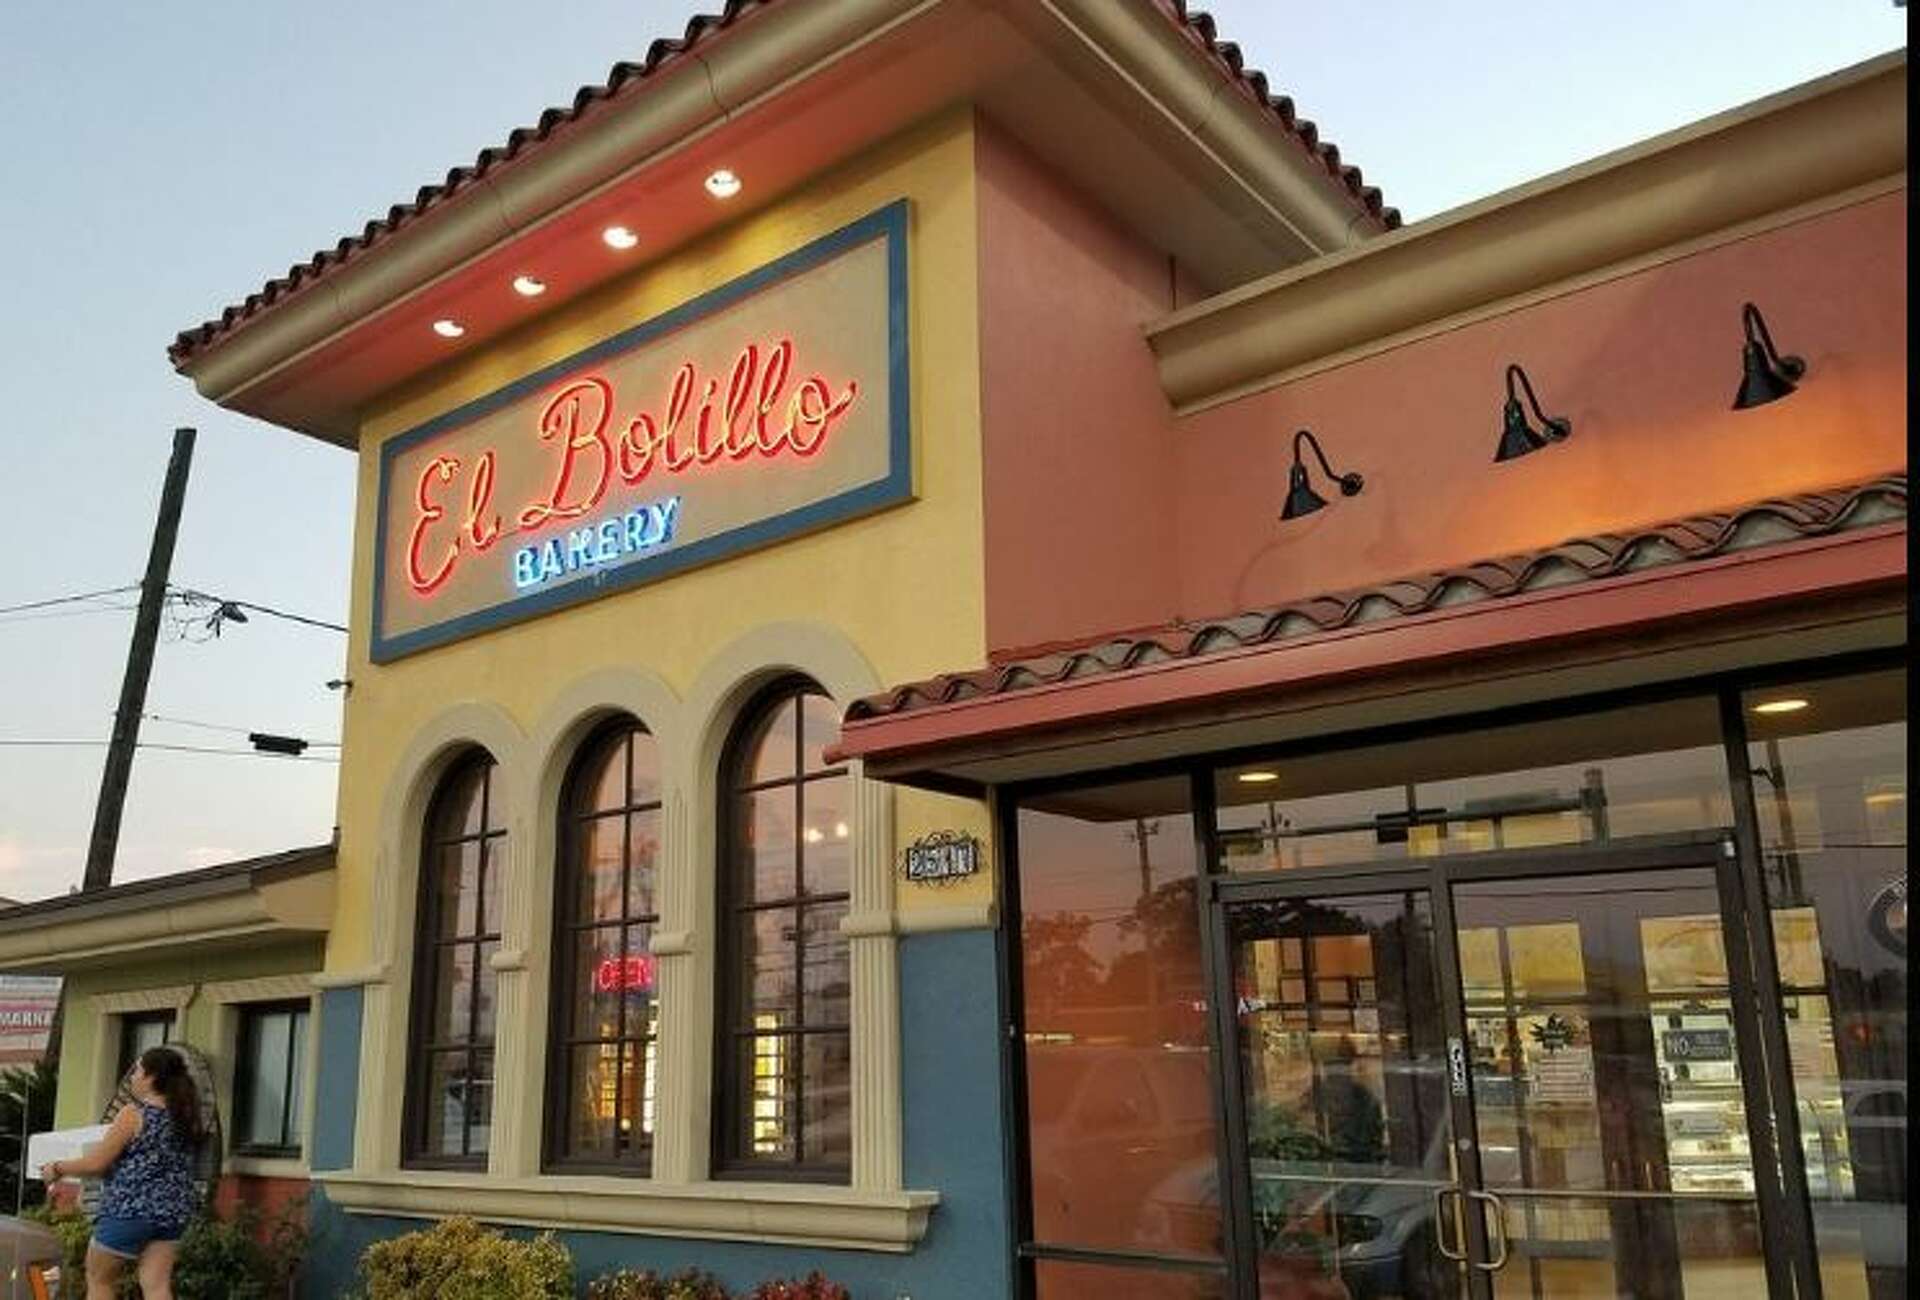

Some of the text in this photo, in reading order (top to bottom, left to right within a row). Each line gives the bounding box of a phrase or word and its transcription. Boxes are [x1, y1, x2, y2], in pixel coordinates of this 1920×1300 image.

[405, 339, 858, 596] El Bolillo
[514, 497, 681, 588] BAKERY
